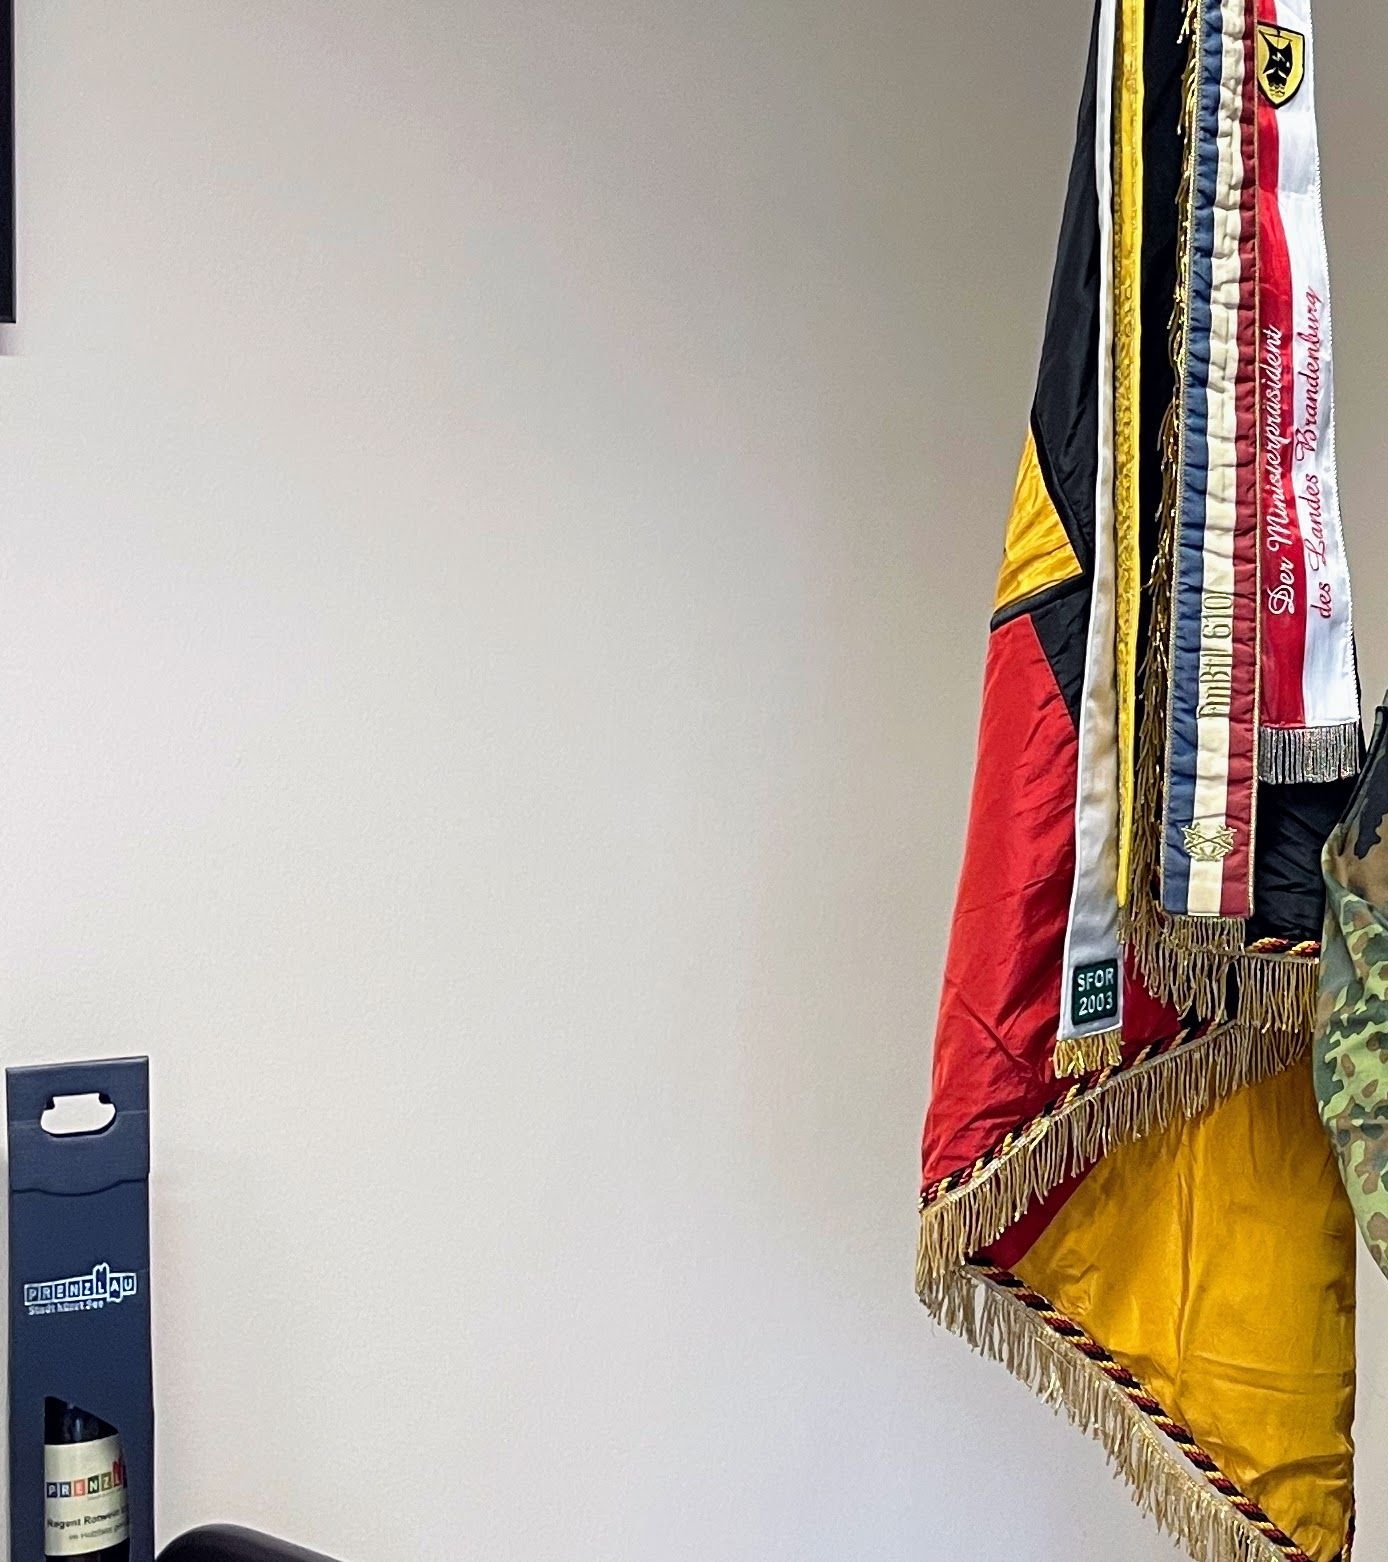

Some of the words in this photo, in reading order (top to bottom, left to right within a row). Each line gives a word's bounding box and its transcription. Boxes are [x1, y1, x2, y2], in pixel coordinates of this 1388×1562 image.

[1294, 285, 1323, 462] Brandenburg
[1298, 473, 1327, 572] Landes
[1268, 557, 1295, 615] Der
[1310, 581, 1332, 619] des
[1202, 595, 1234, 639] 610
[1077, 967, 1114, 992] SFOR
[1078, 991, 1113, 1016] 2003
[24, 1272, 136, 1303] PRENZLAU
